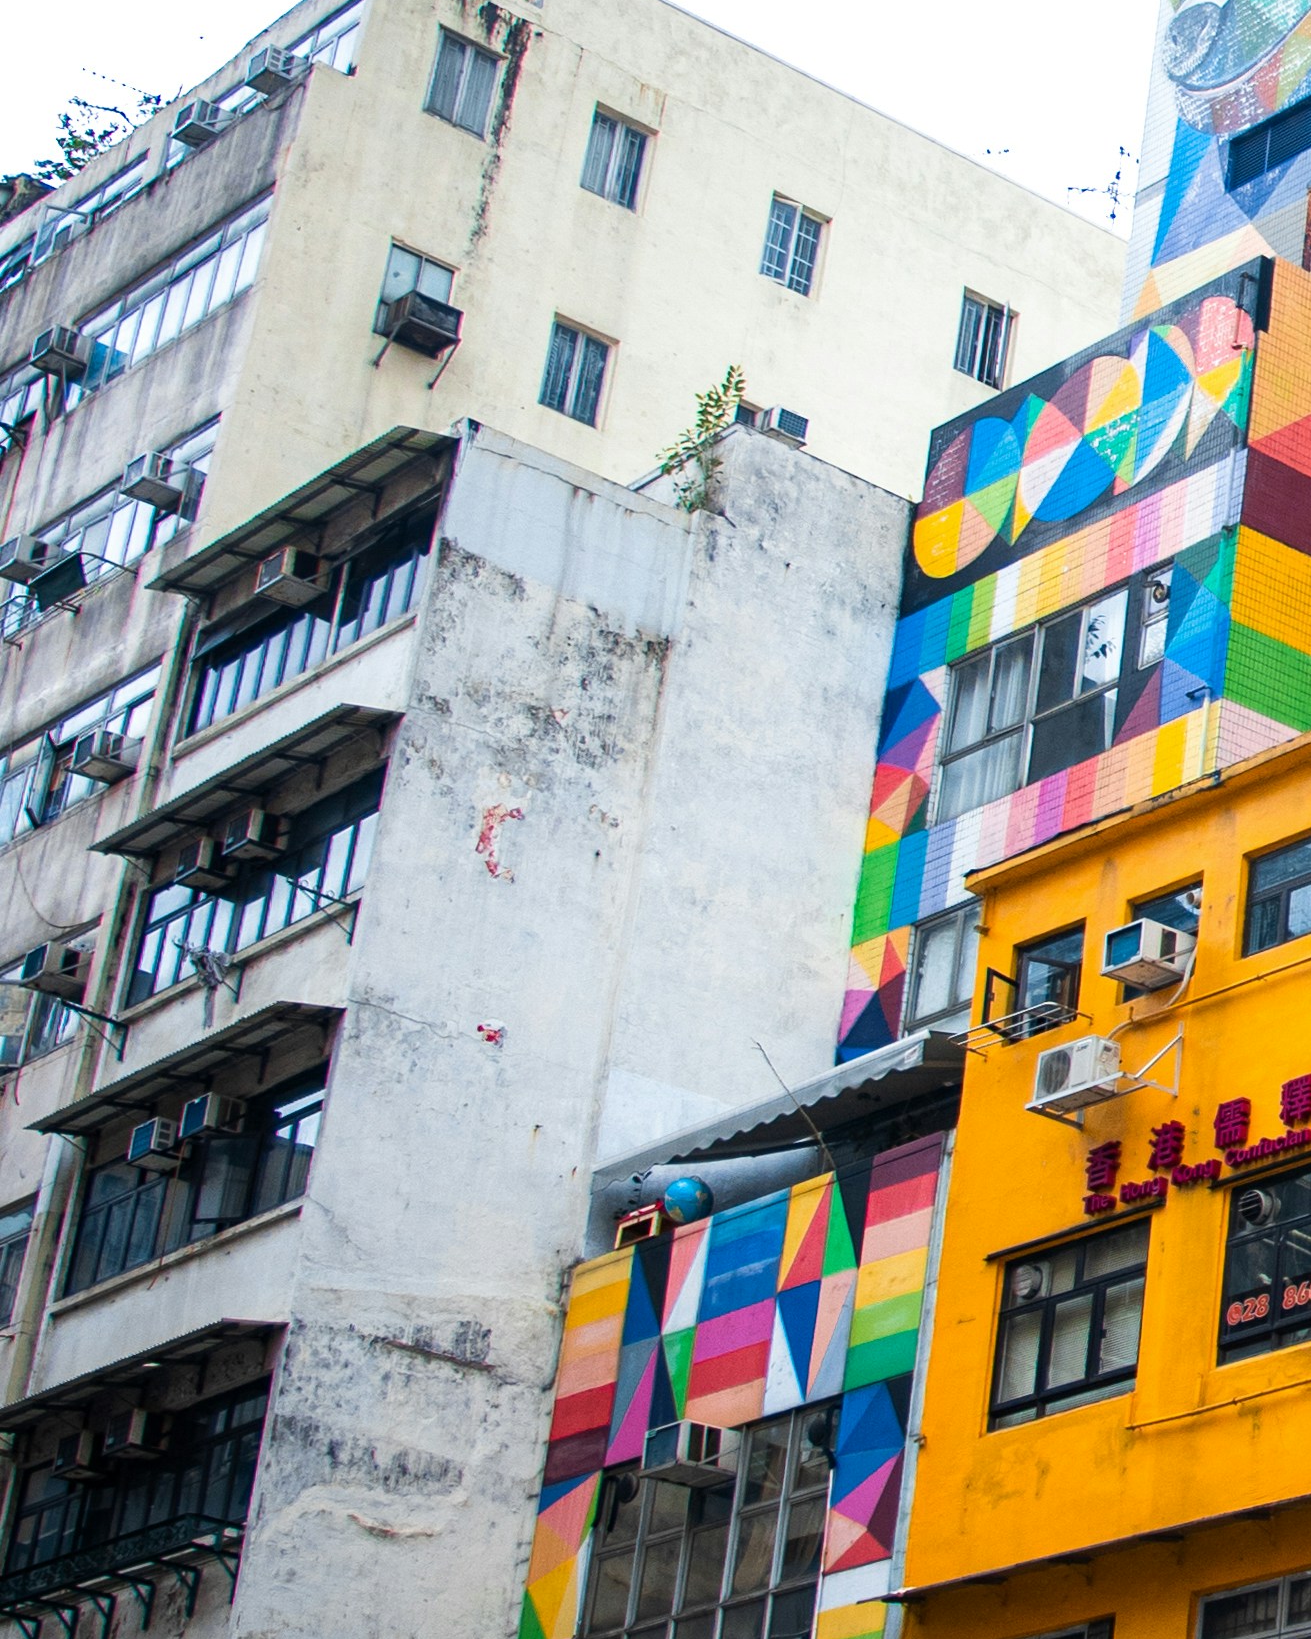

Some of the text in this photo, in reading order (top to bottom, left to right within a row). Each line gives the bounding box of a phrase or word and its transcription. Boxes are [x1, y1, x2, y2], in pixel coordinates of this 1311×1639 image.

[1084, 1194, 1117, 1215] The
[1120, 1177, 1168, 1204] Hong
[1171, 1159, 1222, 1187] Kong
